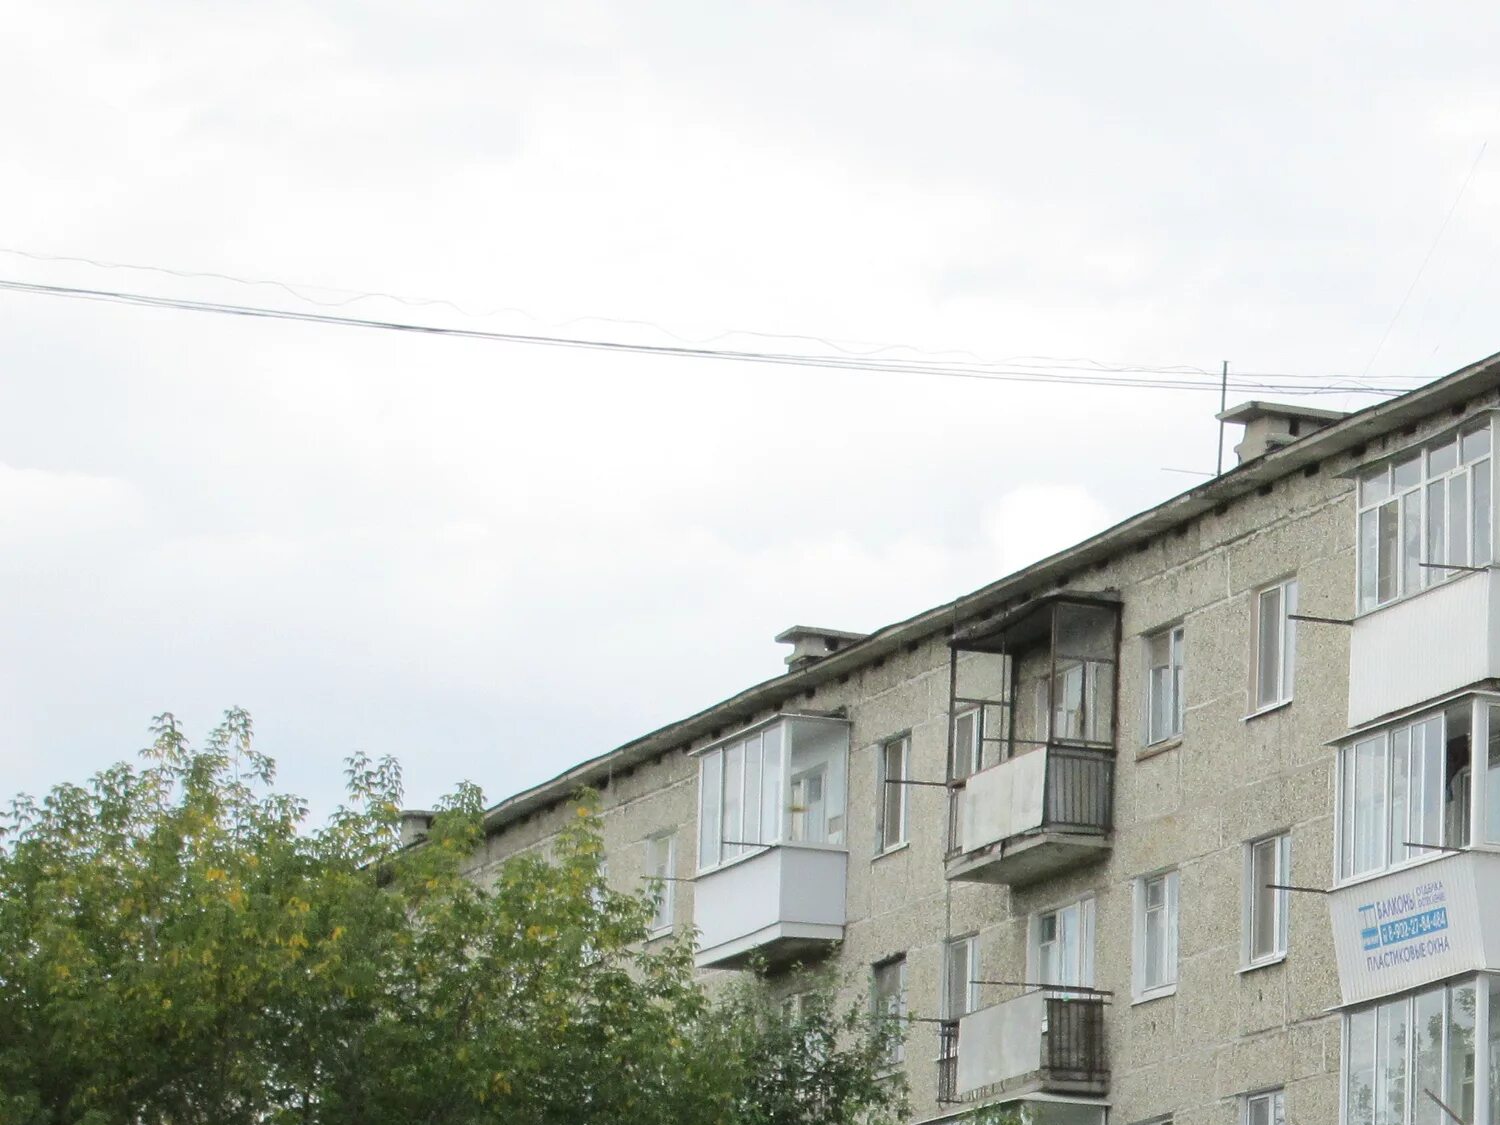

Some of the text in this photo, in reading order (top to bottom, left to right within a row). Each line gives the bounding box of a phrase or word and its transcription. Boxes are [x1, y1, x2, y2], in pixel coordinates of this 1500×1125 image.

[1377, 892, 1415, 919] БАЛКОНЫ
[1367, 936, 1450, 971] ПЛАСТИКОВЫЕ ОКНА
